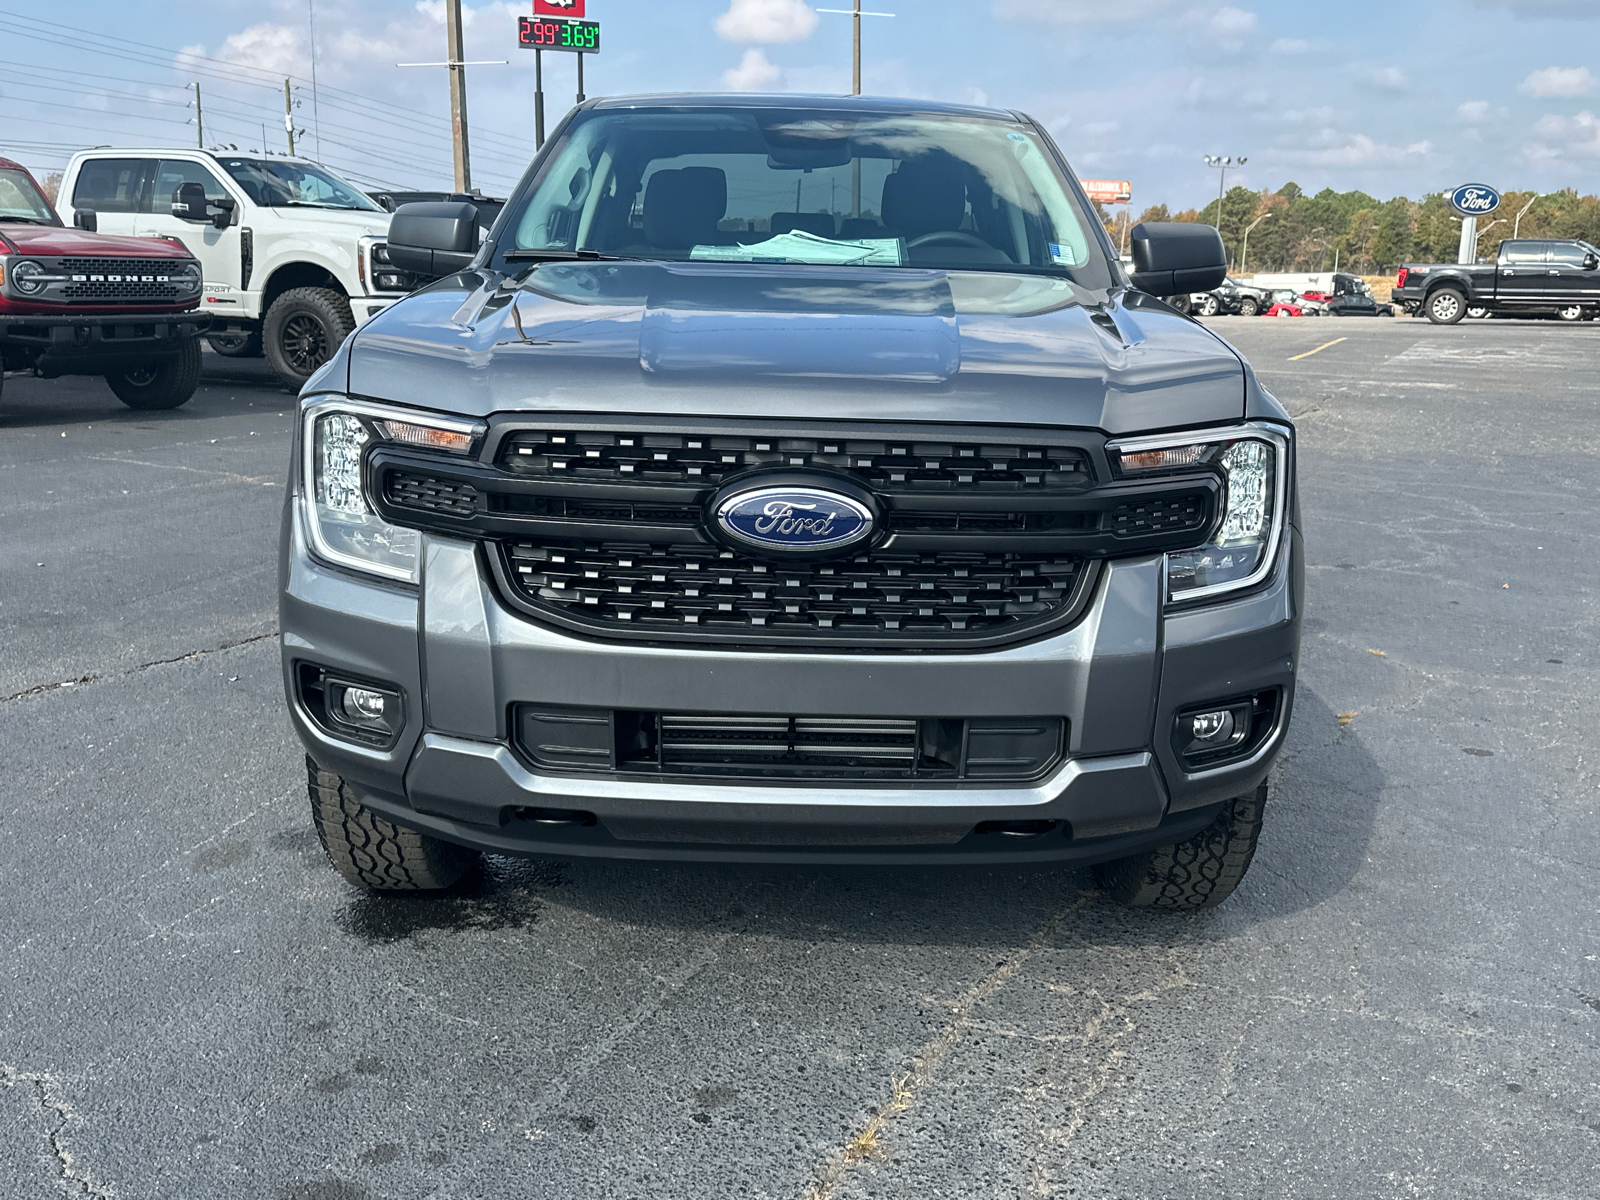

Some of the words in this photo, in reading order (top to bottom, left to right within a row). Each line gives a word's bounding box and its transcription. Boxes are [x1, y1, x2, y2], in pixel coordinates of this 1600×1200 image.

[1461, 188, 1493, 209] Ford
[72, 274, 169, 282] BRONCO
[755, 500, 837, 536] Ford
